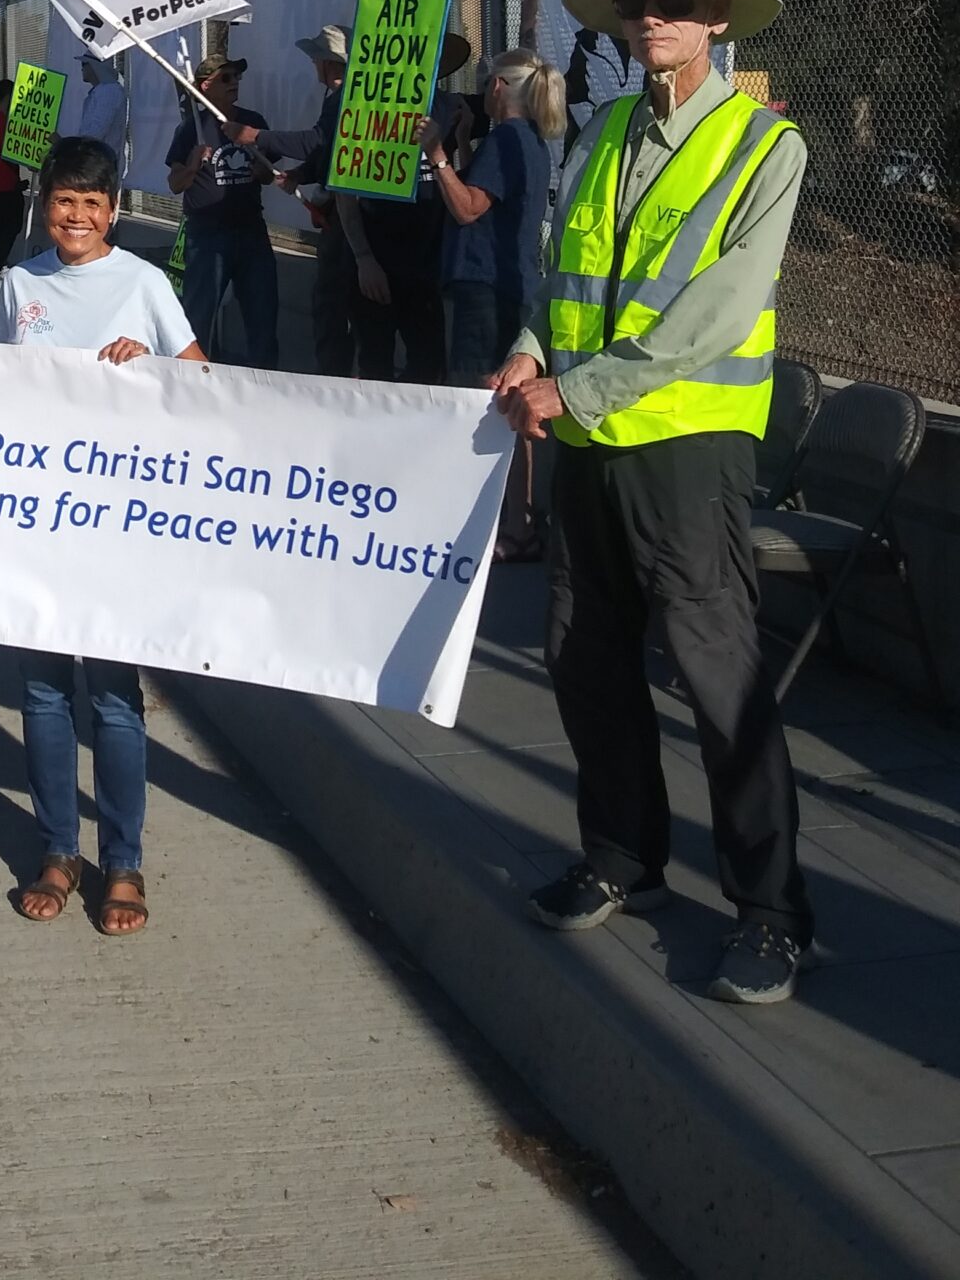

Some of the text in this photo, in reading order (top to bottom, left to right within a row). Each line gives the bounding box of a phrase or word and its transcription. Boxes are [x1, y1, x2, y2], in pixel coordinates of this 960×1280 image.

[359, 33, 428, 66] SHOW
[27, 70, 48, 88] AIR
[349, 70, 427, 105] FUELS
[18, 85, 55, 110] SHOW
[7, 119, 52, 145] CLIMATE
[14, 103, 50, 128] FUELS
[339, 108, 423, 146] CLIMATE
[6, 138, 43, 163] CRISIS
[336, 145, 410, 185] CRISIS
[63, 440, 190, 485] Christi
[204, 455, 271, 495] San
[286, 465, 397, 518] Diego
[50, 491, 111, 532] for
[123, 499, 237, 546] Peace
[252, 518, 340, 561] with
[352, 532, 480, 585] Justic
